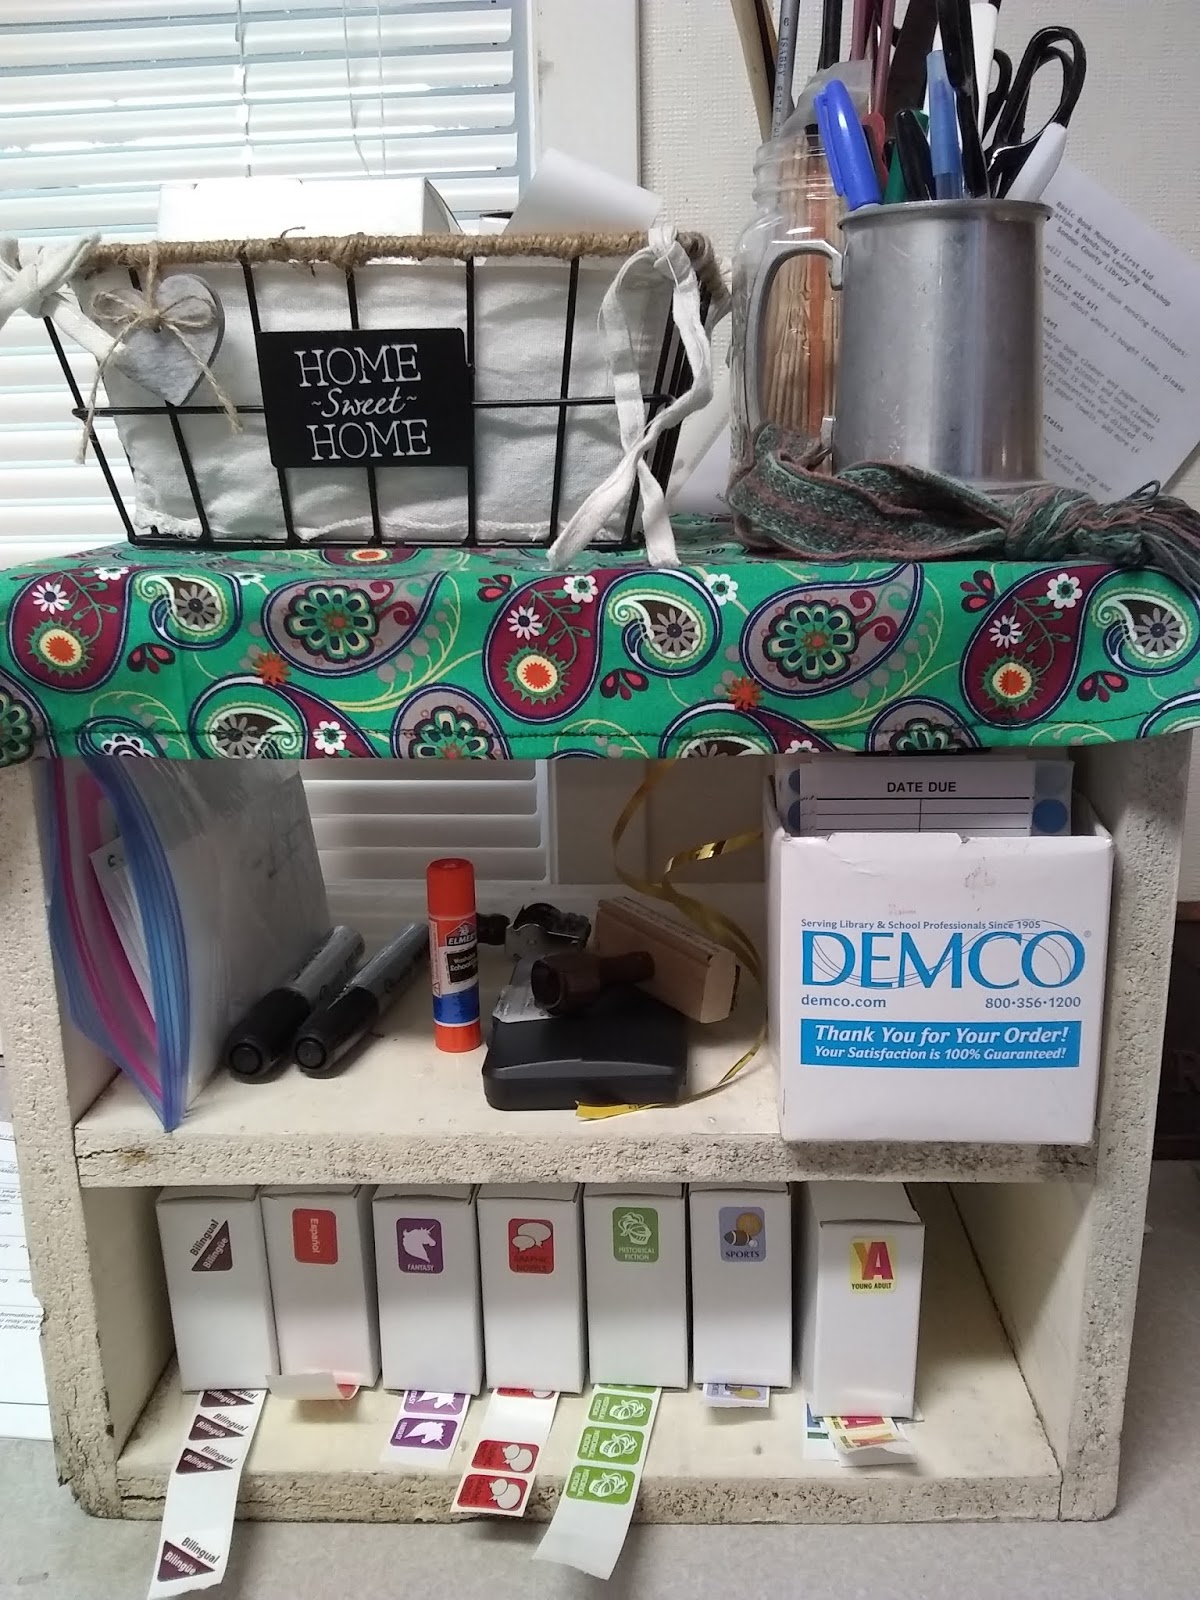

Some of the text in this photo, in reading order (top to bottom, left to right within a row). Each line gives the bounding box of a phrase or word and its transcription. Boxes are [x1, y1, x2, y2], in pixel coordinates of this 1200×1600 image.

[1056, 201, 1155, 281] Basic Book Mending First Aid
[1054, 213, 1073, 229] ation
[1112, 257, 1140, 284] Learning
[1142, 281, 1171, 307] Workshop
[1056, 226, 1130, 287] Sonoma County Library
[1053, 273, 1099, 312] first aid kit
[294, 343, 422, 388] HOME
[1162, 374, 1187, 394] please
[306, 418, 432, 461] HOME
[886, 781, 957, 793] DATE DUE
[801, 918, 1041, 931] Serving Library & School Professionals Since 1905
[802, 930, 1086, 990] DEMCO
[801, 994, 887, 1009] demco.com
[815, 1024, 1069, 1048] Thank You for Your Order!
[814, 1045, 1067, 1061] Your Satisfaction is 100% Guaranteed!
[190, 1219, 219, 1256] Bilingual
[310, 1218, 320, 1253] Español
[202, 1238, 229, 1269] Bilingüe
[618, 1246, 655, 1254] HISTORICAL
[725, 1250, 760, 1259] SPORTS
[853, 1241, 894, 1281] YA
[407, 1263, 435, 1272] FANTASY
[874, 1282, 892, 1290] ADULT
[195, 1421, 226, 1438] Bilingüe
[213, 1413, 250, 1432] Bilingual
[183, 1454, 215, 1471] Bilingüe
[201, 1446, 238, 1465] Bilingual
[181, 1537, 221, 1565] Bilingual
[163, 1551, 198, 1576] Bilingüe
